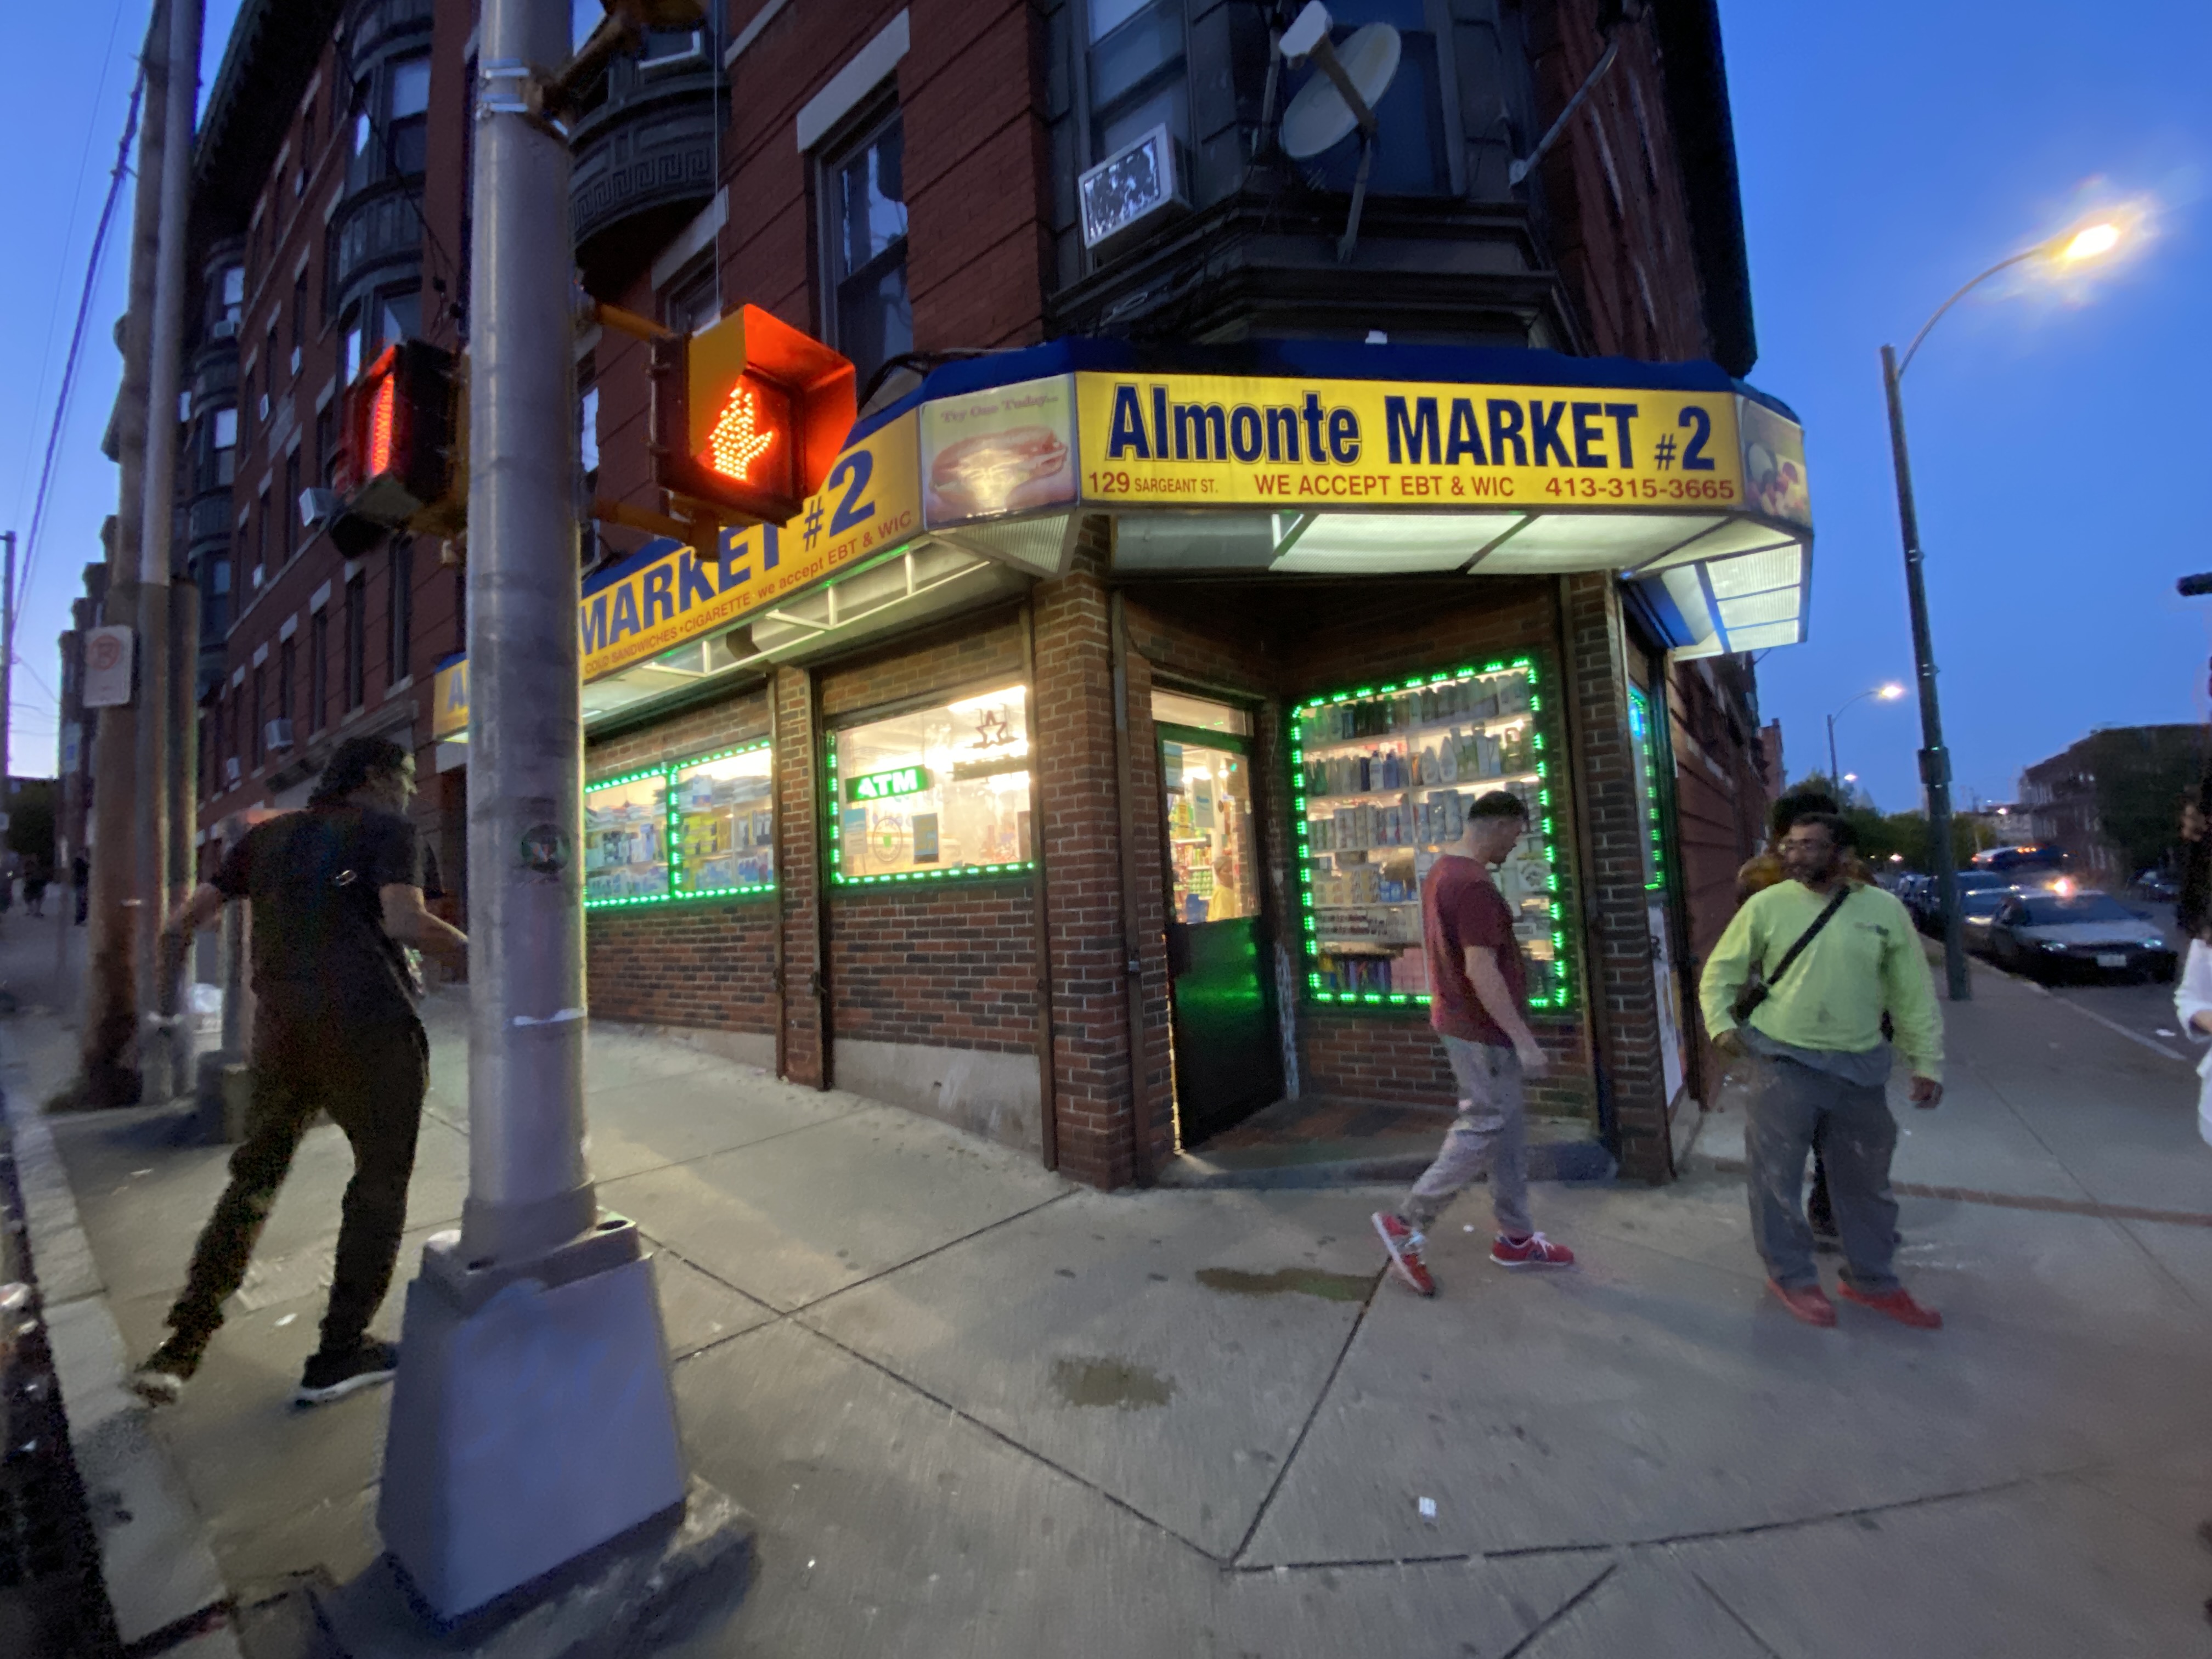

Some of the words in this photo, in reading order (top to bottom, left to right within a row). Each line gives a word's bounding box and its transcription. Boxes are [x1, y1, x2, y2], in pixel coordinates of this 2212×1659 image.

[1105, 383, 1362, 466] Almonte
[1384, 394, 1639, 470] MARKET
[1654, 405, 1716, 471] #2
[1089, 471, 1130, 493] 129
[1135, 477, 1197, 493] SARGEANT
[1200, 478, 1218, 493] ST.
[1254, 474, 1290, 495] WE
[1298, 475, 1390, 496] ACCEPT
[1401, 476, 1443, 496] EBT
[1451, 476, 1465, 496] &
[1471, 476, 1515, 497] WIC
[1544, 477, 1735, 500] 413-315-3665
[803, 449, 876, 552] #2
[585, 656, 610, 674] COLD
[611, 626, 678, 664] SANDWICHES
[684, 592, 751, 634] CIGARETTE
[757, 583, 775, 599] we
[779, 557, 824, 589] accept
[827, 538, 857, 566] EBT
[862, 531, 873, 548] &
[877, 510, 912, 539] WIC
[857, 768, 918, 799] ATM
